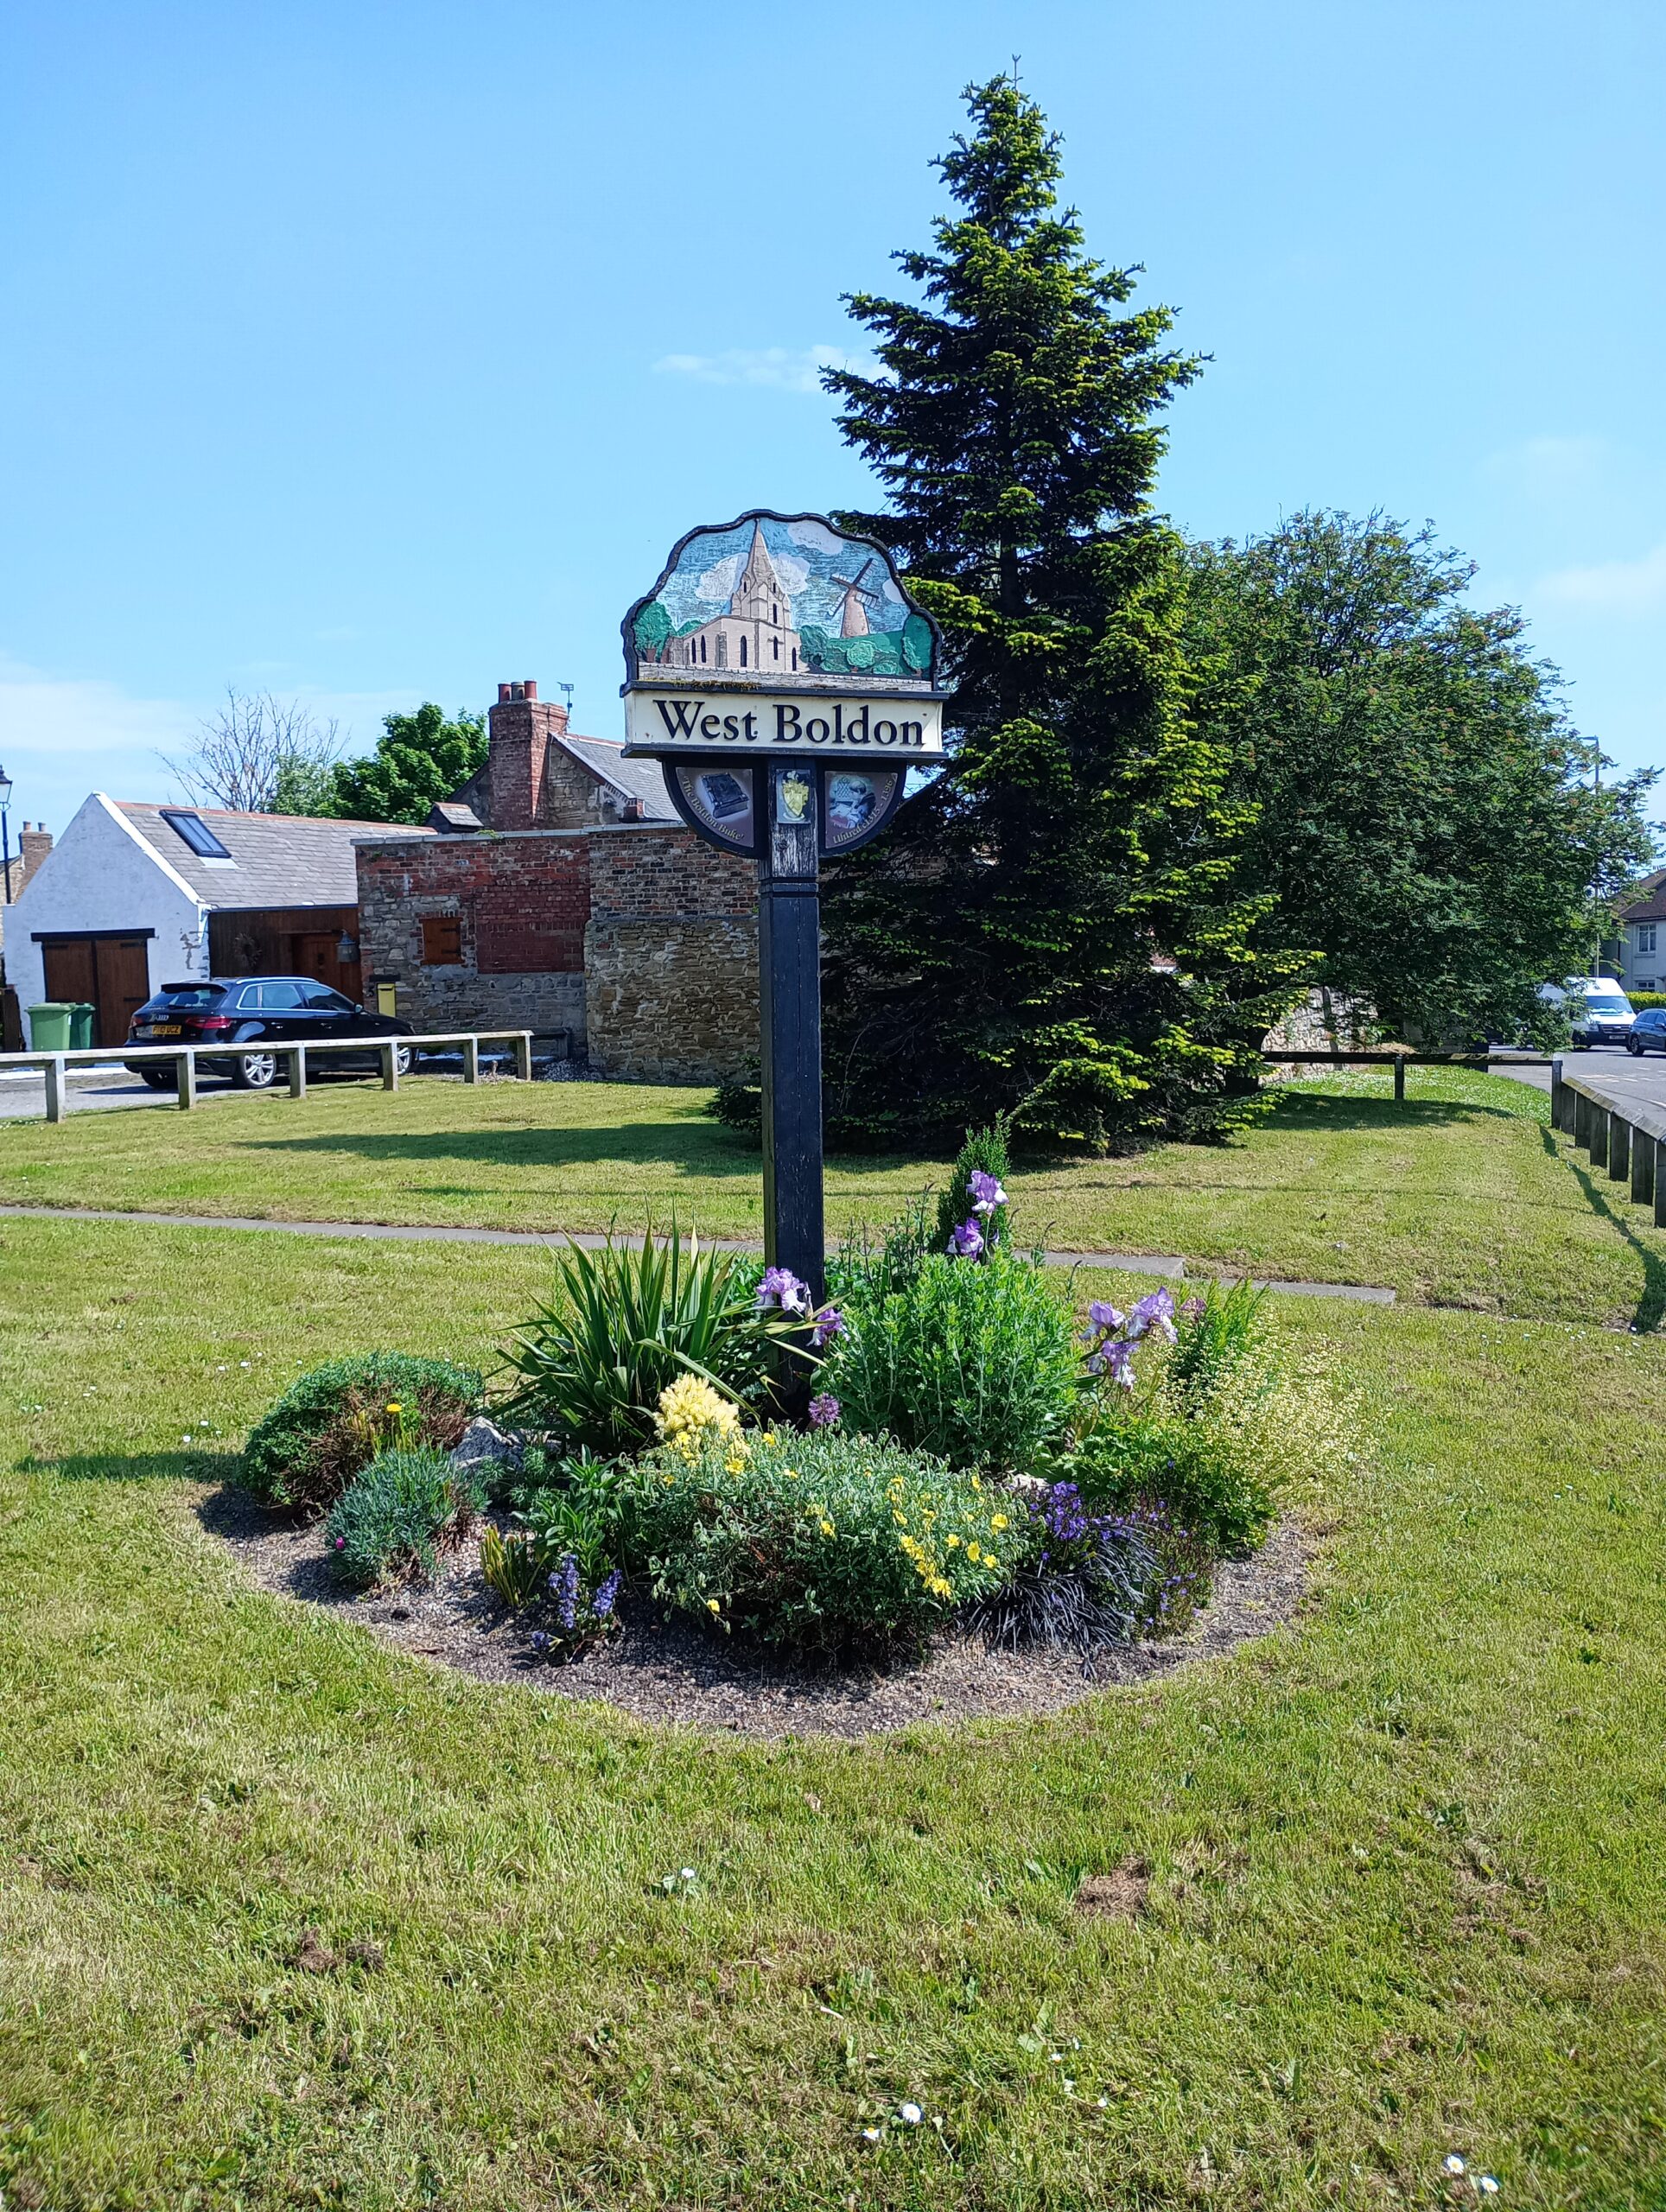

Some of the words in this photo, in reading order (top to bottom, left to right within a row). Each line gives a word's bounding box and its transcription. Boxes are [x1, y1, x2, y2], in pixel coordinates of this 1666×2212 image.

[652, 699, 758, 741] West
[773, 703, 925, 746] Boldon
[691, 797, 717, 827] Boldon
[832, 823, 862, 844] Uhtred
